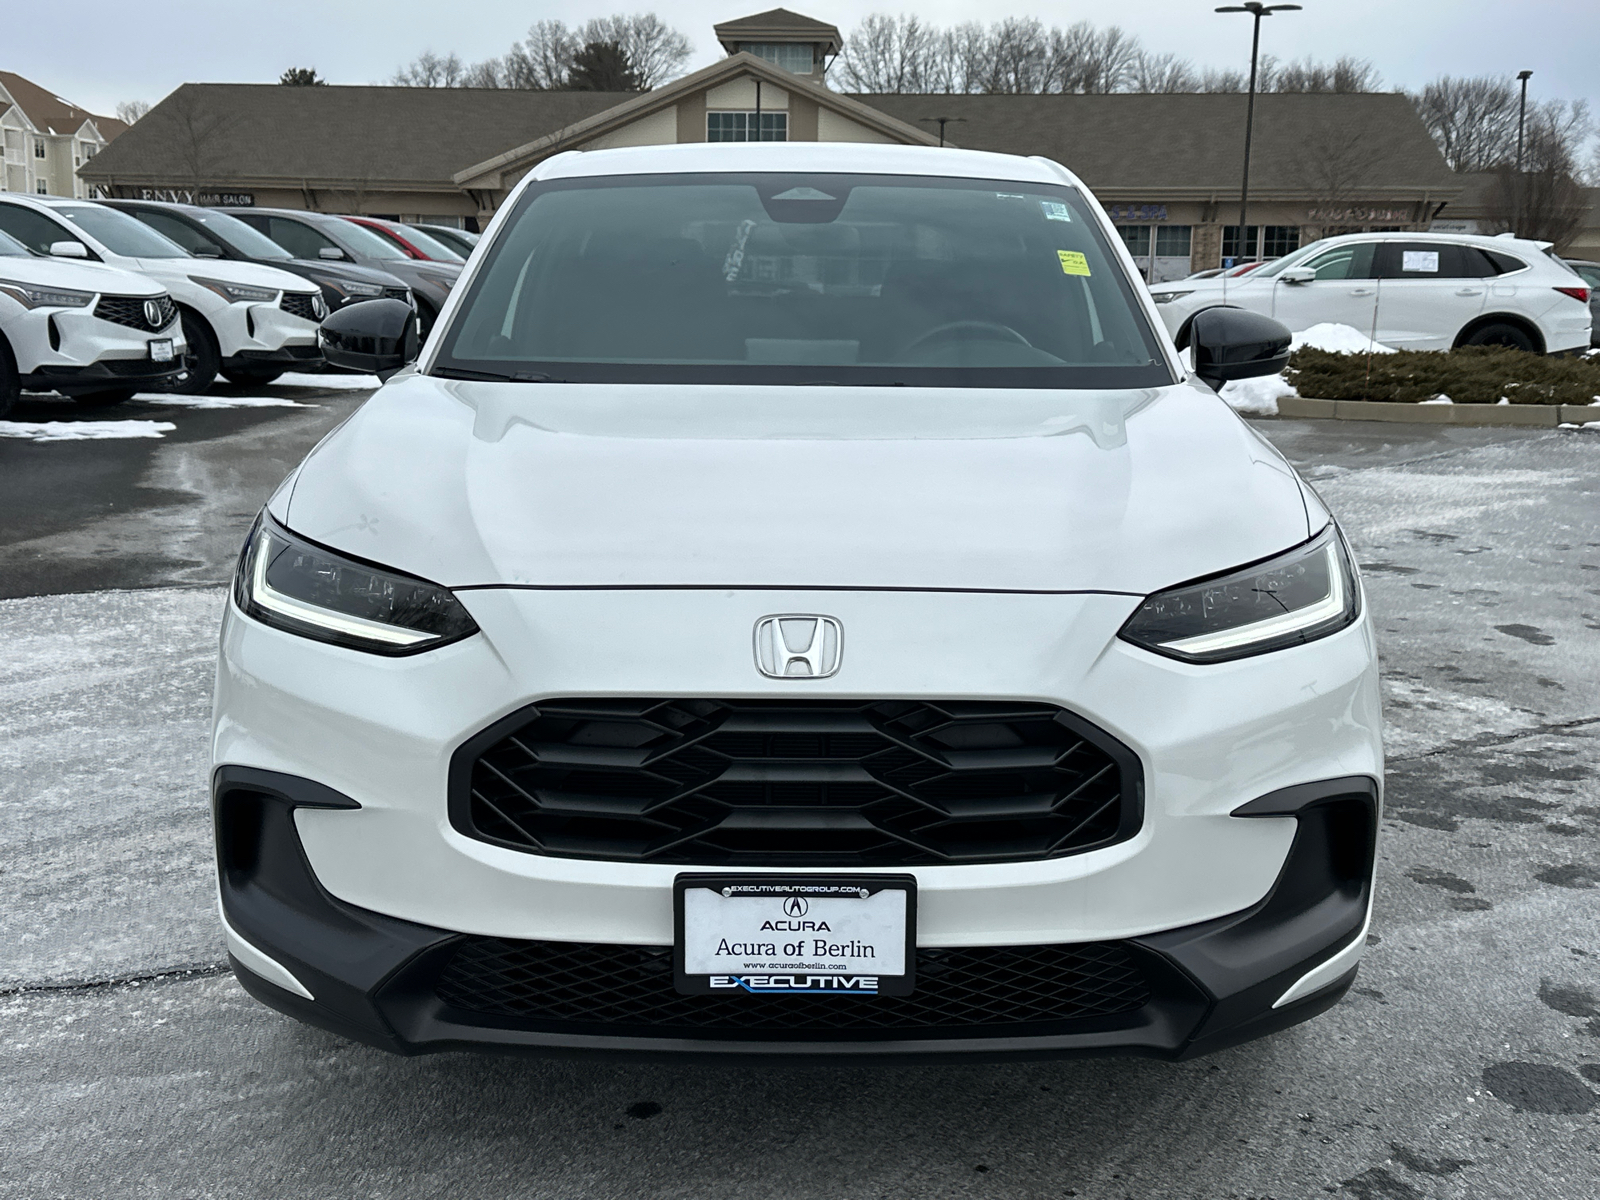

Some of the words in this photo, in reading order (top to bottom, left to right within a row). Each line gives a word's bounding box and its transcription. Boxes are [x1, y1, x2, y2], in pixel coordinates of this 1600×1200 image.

[141, 189, 195, 204] ENVY
[222, 194, 252, 205] SALON
[1141, 205, 1167, 219] SPA
[731, 885, 861, 893] EXECUTIVEAUTOGROUP.COM
[760, 921, 831, 932] ACURA
[715, 938, 777, 956] Acura
[783, 941, 806, 956] of
[812, 939, 876, 958] Berlin
[709, 975, 879, 991] EXECUTIVE
